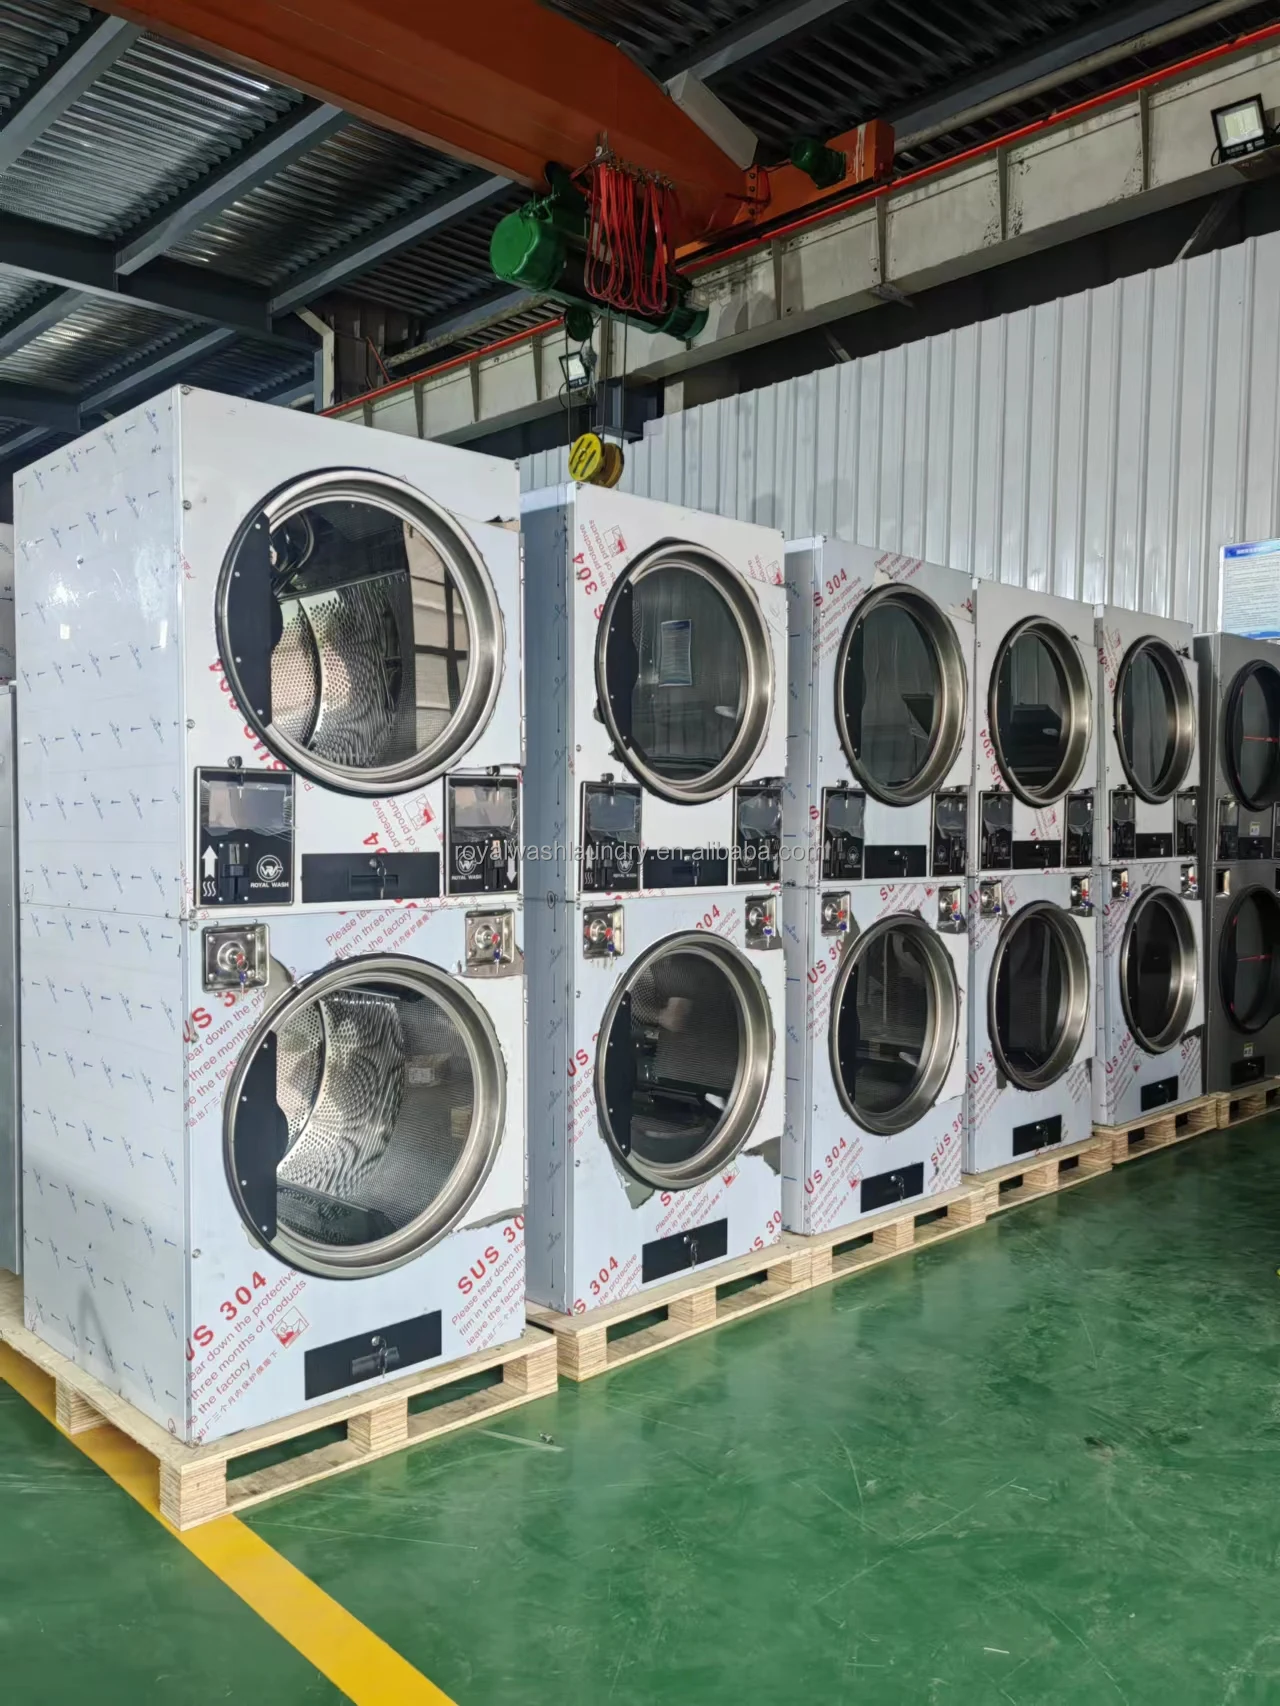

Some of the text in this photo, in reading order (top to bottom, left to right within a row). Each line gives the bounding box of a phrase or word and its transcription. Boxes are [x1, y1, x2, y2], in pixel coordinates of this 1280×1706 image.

[580, 524, 602, 571] protective
[572, 552, 598, 595] 304
[826, 568, 847, 595] 304
[372, 800, 401, 848] protective
[325, 918, 357, 946] Please
[353, 933, 363, 946] in
[362, 914, 386, 937] three
[368, 935, 384, 953] the
[383, 909, 413, 938] factory
[204, 1020, 233, 1046] down
[232, 1004, 250, 1021] the
[189, 1055, 217, 1081] three
[196, 1058, 239, 1097] the fact
[825, 1137, 847, 1169] 304
[655, 1207, 676, 1233] Please
[677, 1200, 693, 1220] three
[691, 1192, 710, 1218] factory
[451, 1293, 480, 1326] Please
[477, 1276, 493, 1296] tear
[493, 1253, 514, 1278] down
[457, 1245, 500, 1295] SUS
[589, 1256, 619, 1296] 304
[609, 1253, 638, 1293] protective
[206, 1332, 235, 1363] down
[233, 1314, 253, 1333] the
[252, 1267, 299, 1317] protective
[219, 1270, 267, 1321] 304
[459, 1317, 476, 1336] film
[474, 1307, 484, 1320] in
[482, 1286, 503, 1310] three
[190, 1371, 219, 1401] three
[219, 1334, 257, 1372] months
[255, 1320, 268, 1335] of
[266, 1280, 307, 1323] products
[466, 1320, 489, 1347] leave
[487, 1306, 502, 1322] the
[197, 1358, 251, 1414] the factory
